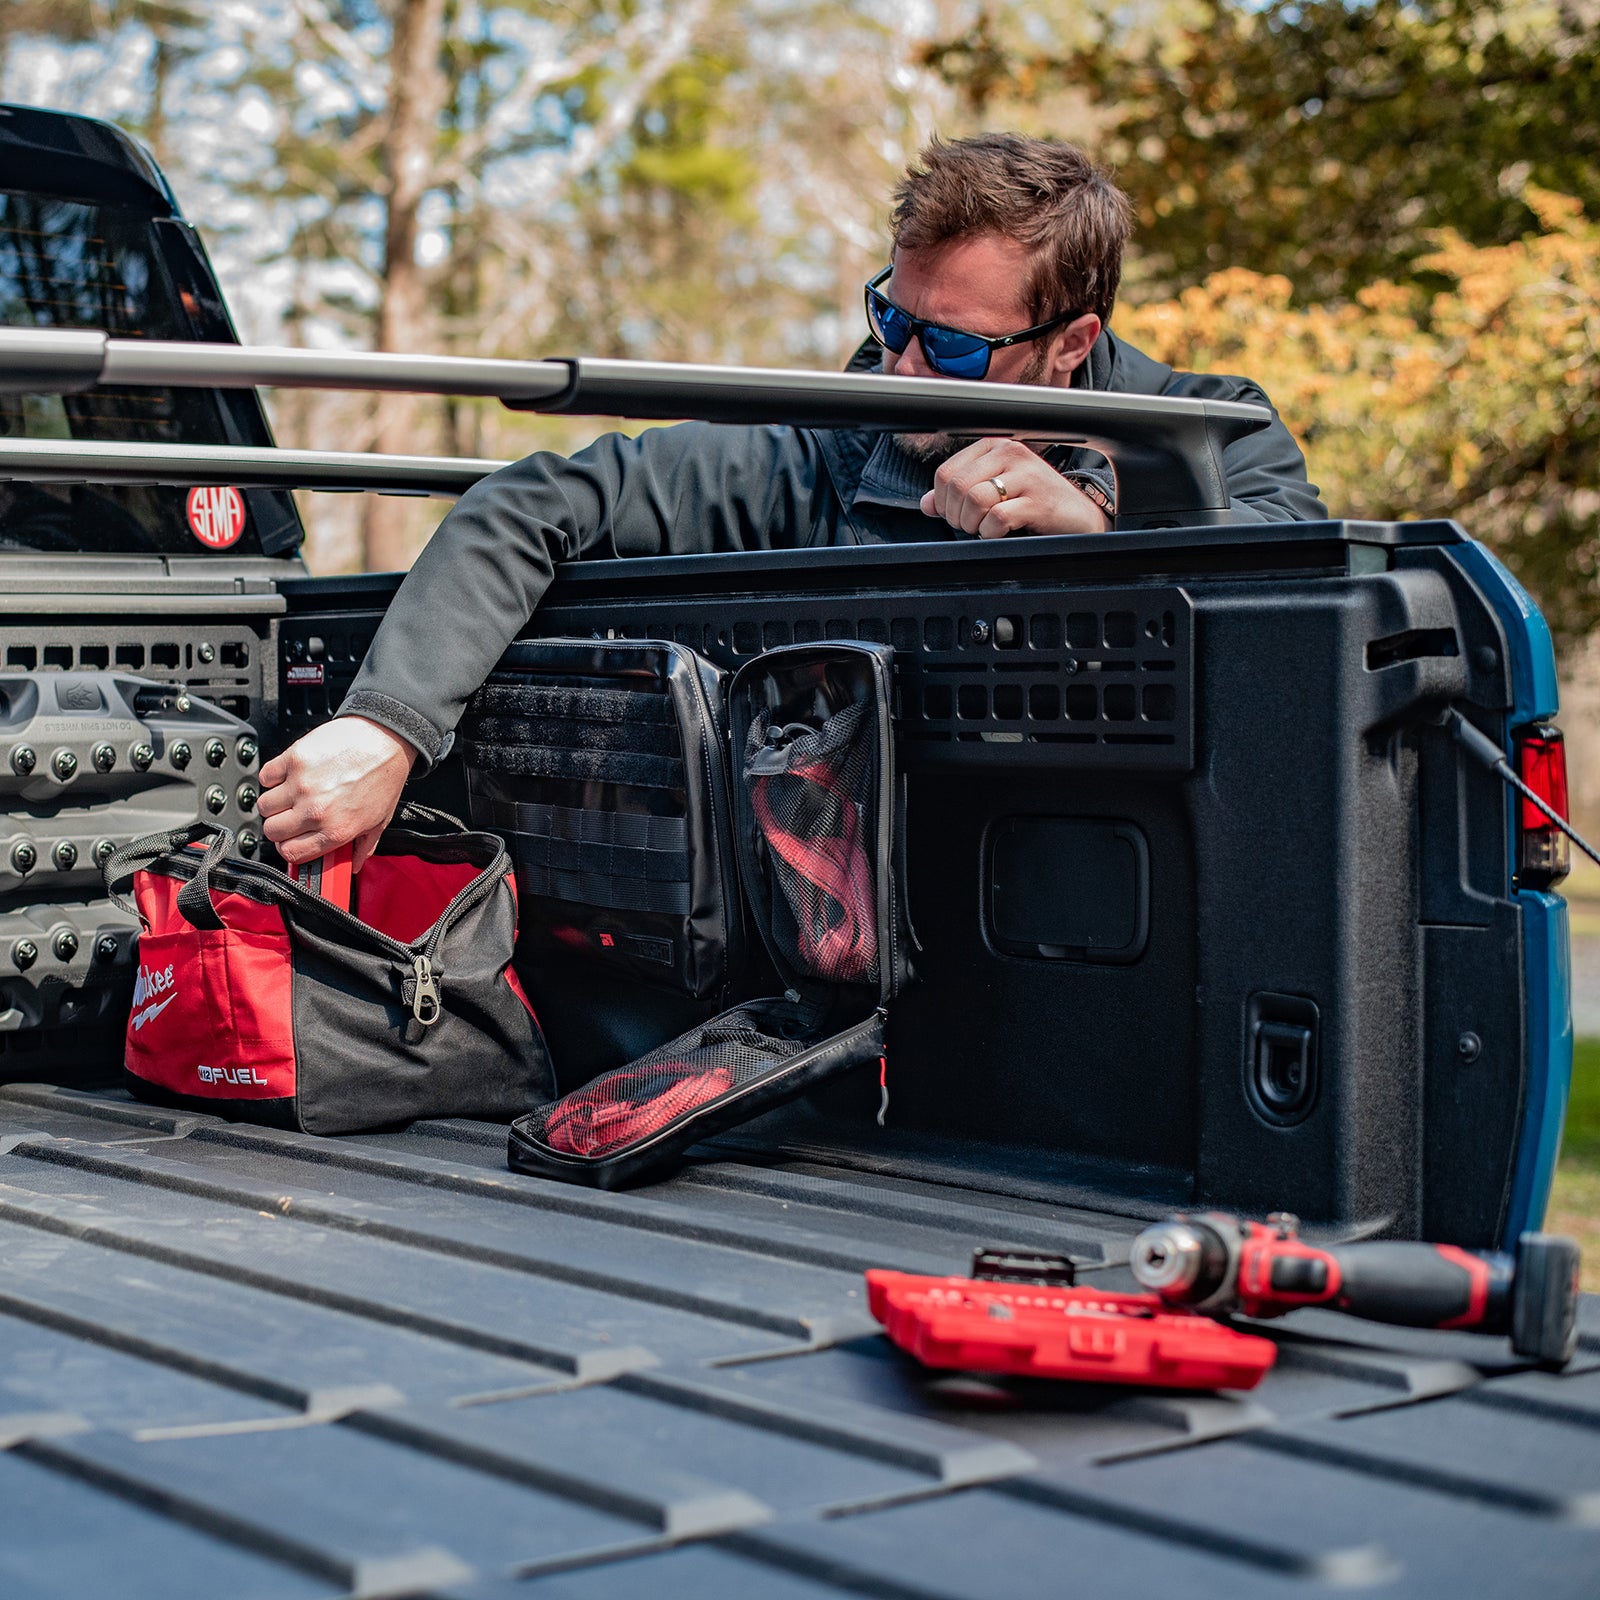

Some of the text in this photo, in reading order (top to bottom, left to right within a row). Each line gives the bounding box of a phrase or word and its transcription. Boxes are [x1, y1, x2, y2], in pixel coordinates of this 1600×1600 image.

[192, 487, 241, 542] SEMA
[102, 722, 118, 730] NOT
[120, 722, 131, 730] DO
[212, 1067, 268, 1085] FUEL
